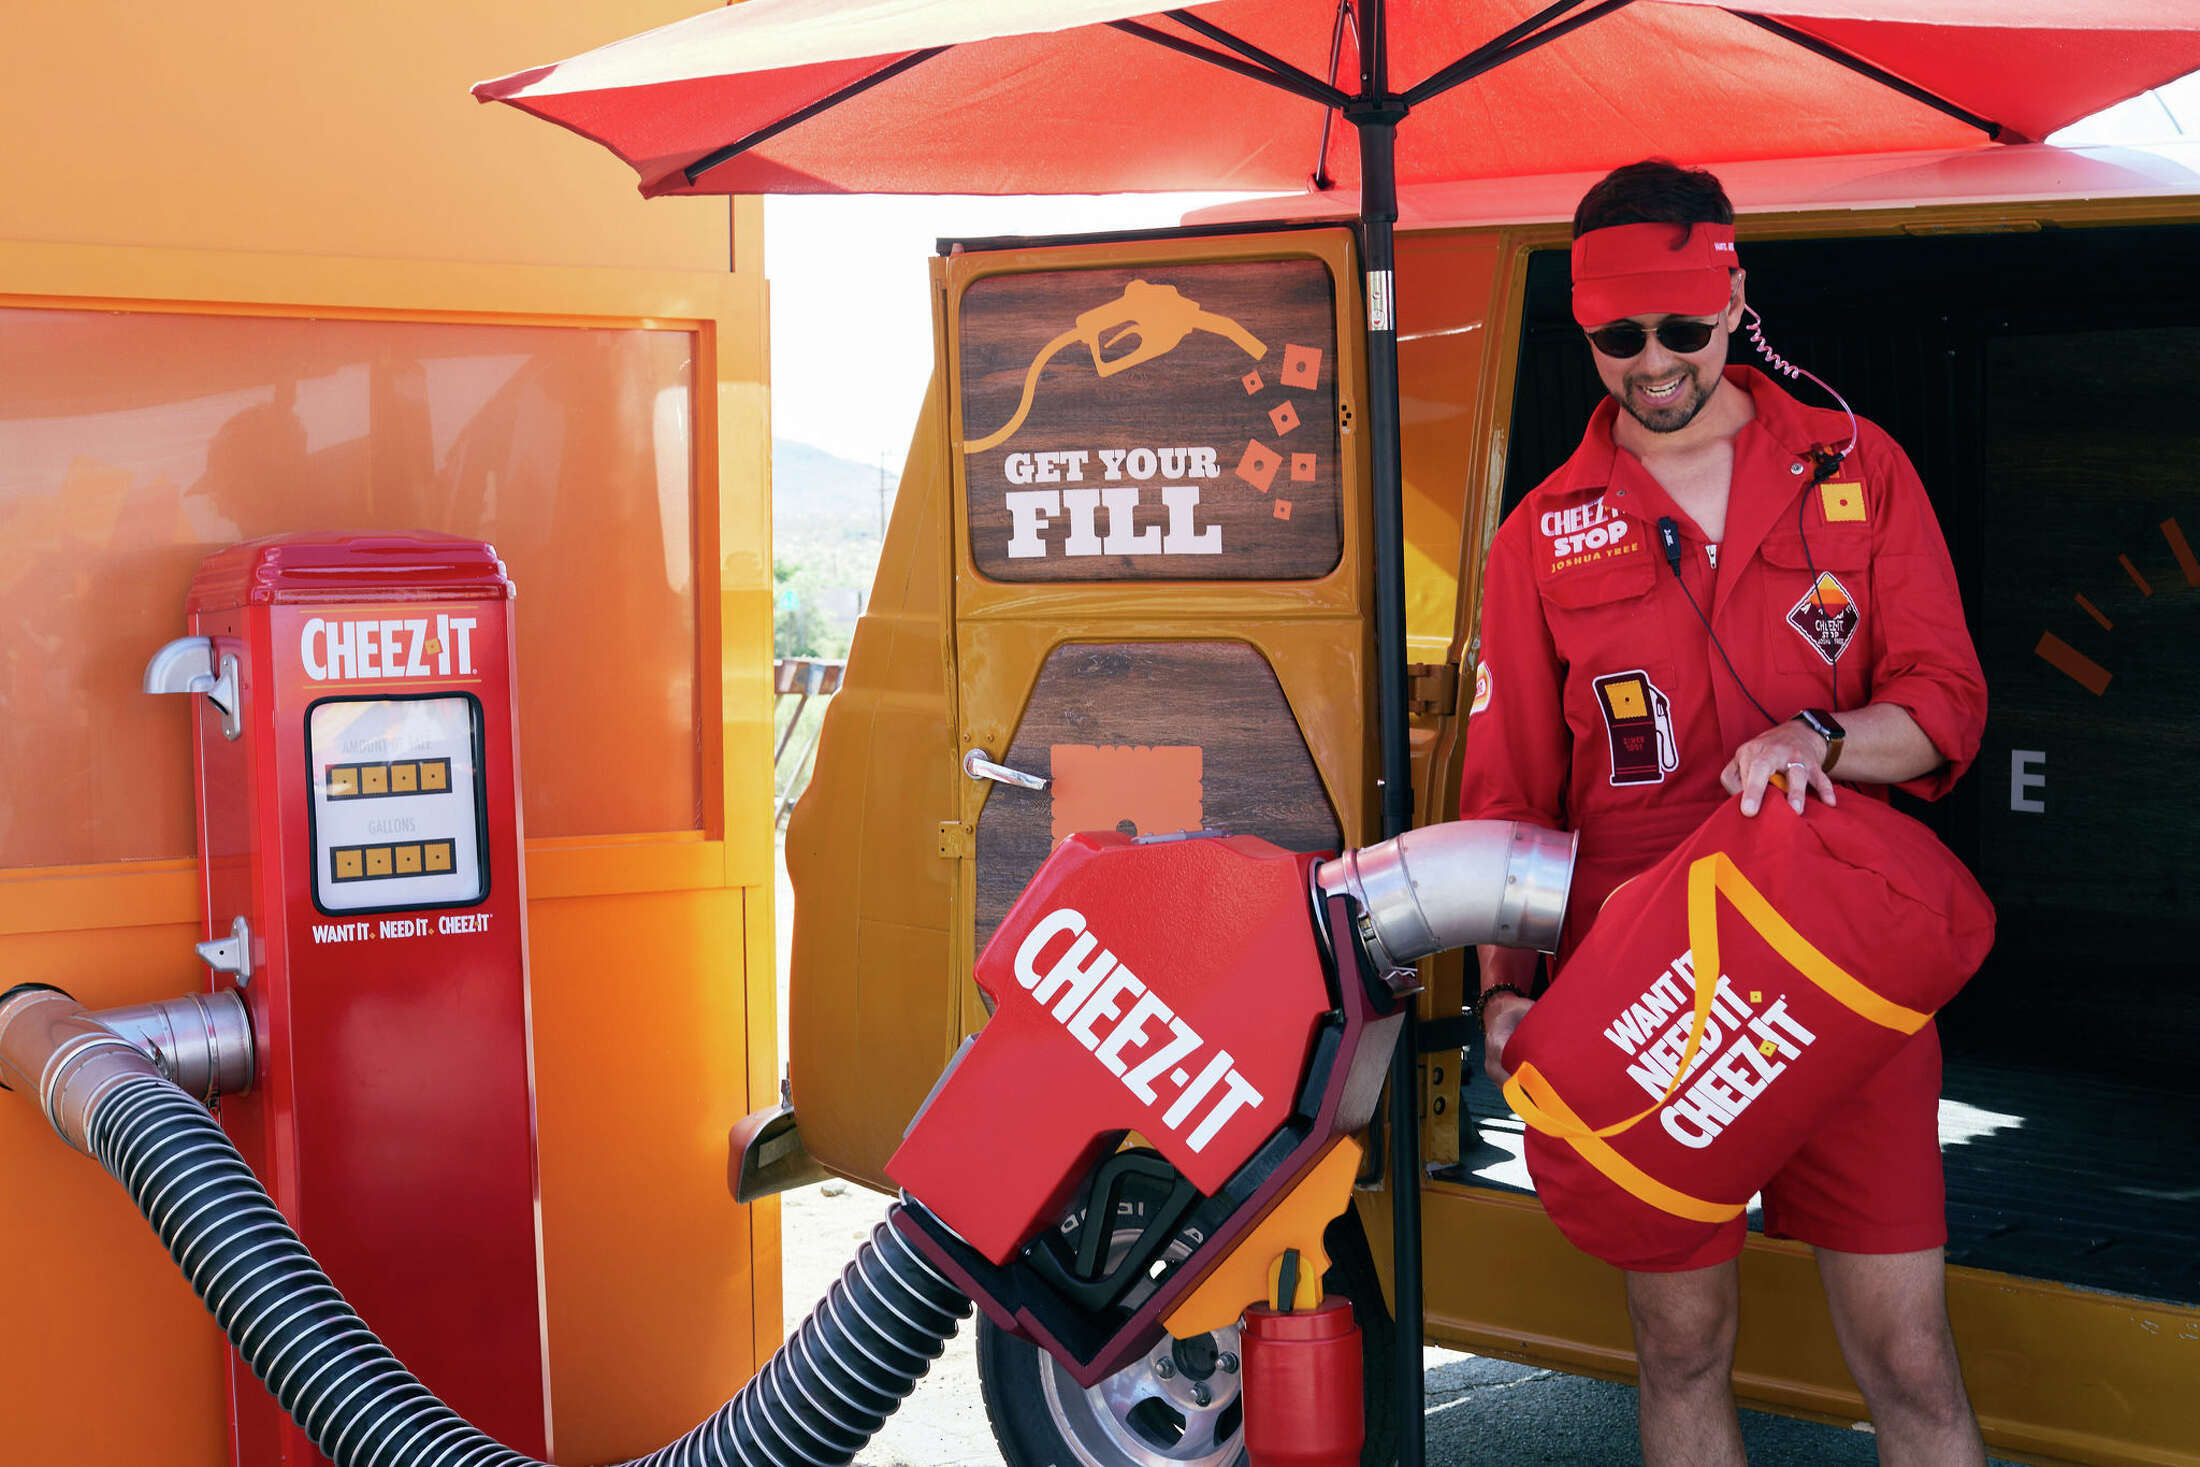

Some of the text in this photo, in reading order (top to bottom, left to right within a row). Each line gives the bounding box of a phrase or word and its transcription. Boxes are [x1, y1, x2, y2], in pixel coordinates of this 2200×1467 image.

[1004, 446, 1221, 484] GET YOUR
[1006, 486, 1222, 558] FILL
[1554, 520, 1628, 557] STOP
[1551, 542, 1638, 574] JOSHUA TREE
[2010, 749, 2046, 814] E
[368, 817, 416, 835] GALLONS
[312, 923, 355, 944] WANT
[379, 919, 415, 940] NEED
[1014, 908, 1263, 1154] CHEEZ-IT
[1603, 970, 1688, 1056] WANT
[1626, 1010, 1723, 1103] NEED
